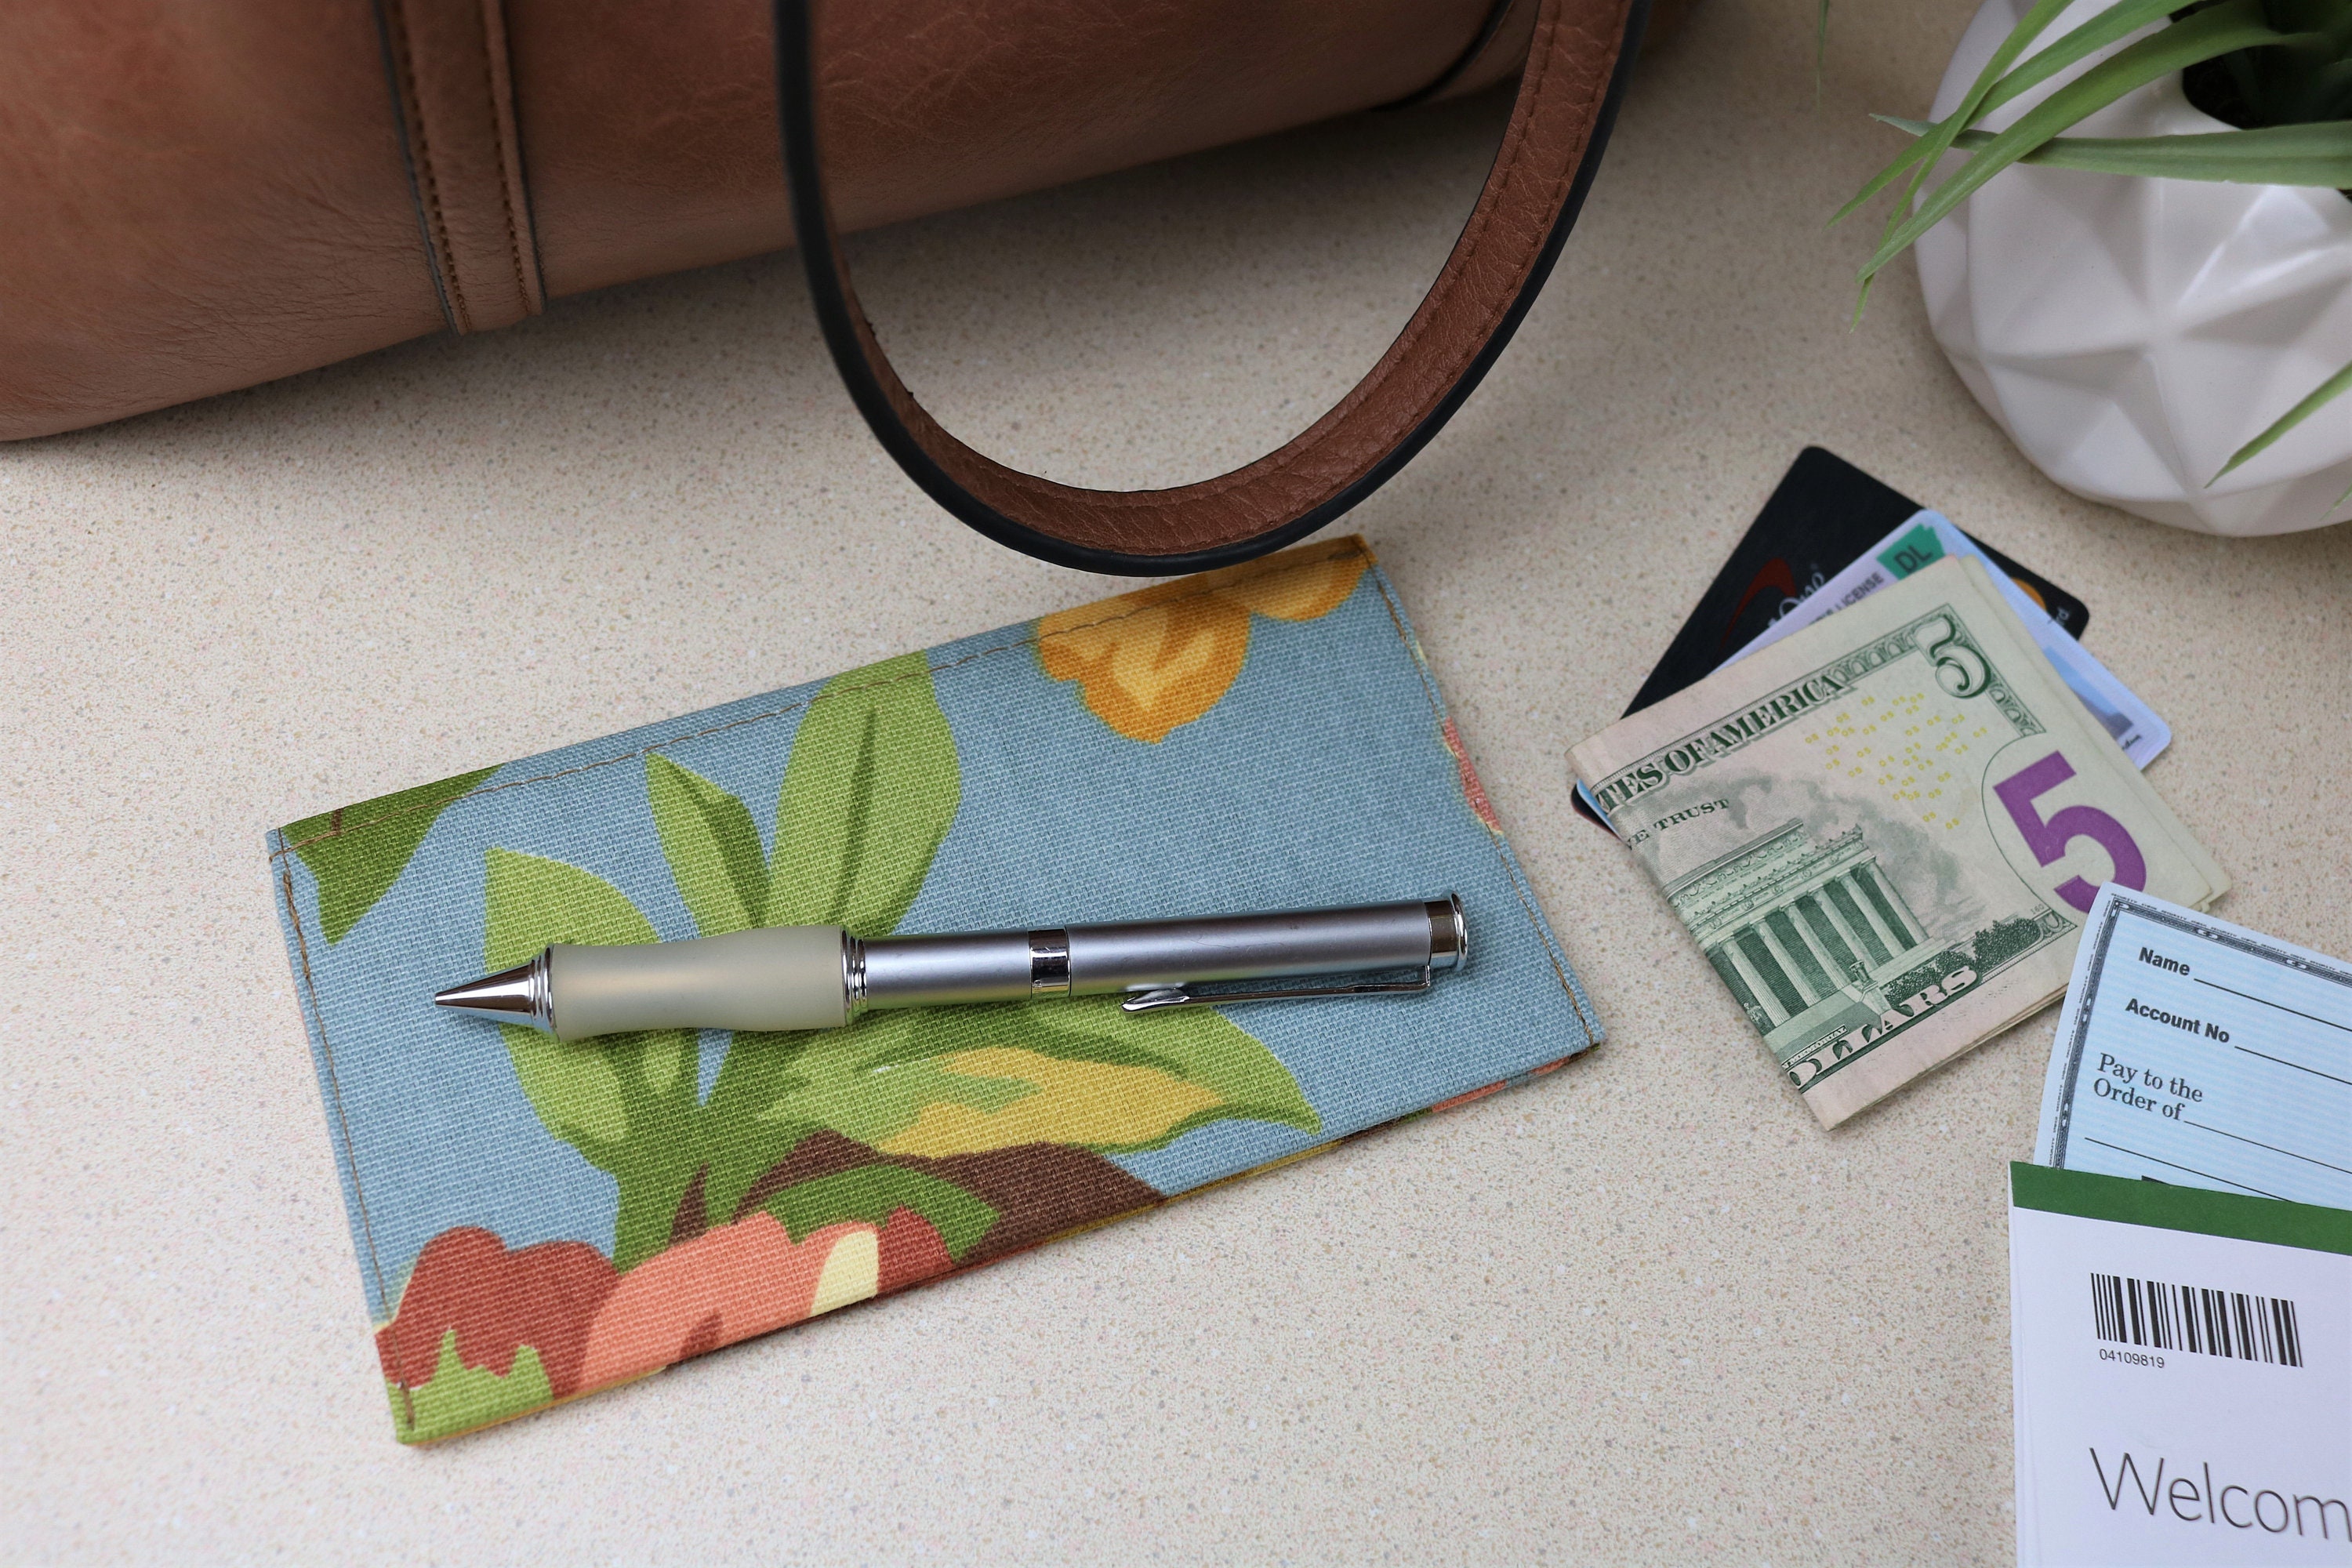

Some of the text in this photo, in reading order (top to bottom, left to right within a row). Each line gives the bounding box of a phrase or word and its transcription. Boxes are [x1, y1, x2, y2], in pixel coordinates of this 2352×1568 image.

[1893, 545, 1933, 574] DL
[1913, 613, 1991, 699] 5
[1664, 739, 1708, 773] OF
[1708, 675, 1846, 754] AMERICA
[1653, 798, 1730, 831] TRUST
[1993, 750, 2147, 914] 5
[2139, 946, 2190, 977] Name
[2125, 997, 2230, 1044] Account No
[2093, 1078, 2157, 1112] Order
[2161, 1103, 2186, 1121] of
[2096, 1052, 2139, 1084] Pay
[2143, 1069, 2163, 1091] to
[2169, 1077, 2204, 1102] the
[2099, 1348, 2165, 1369] 04109819
[2089, 1446, 2352, 1543] Welcom
